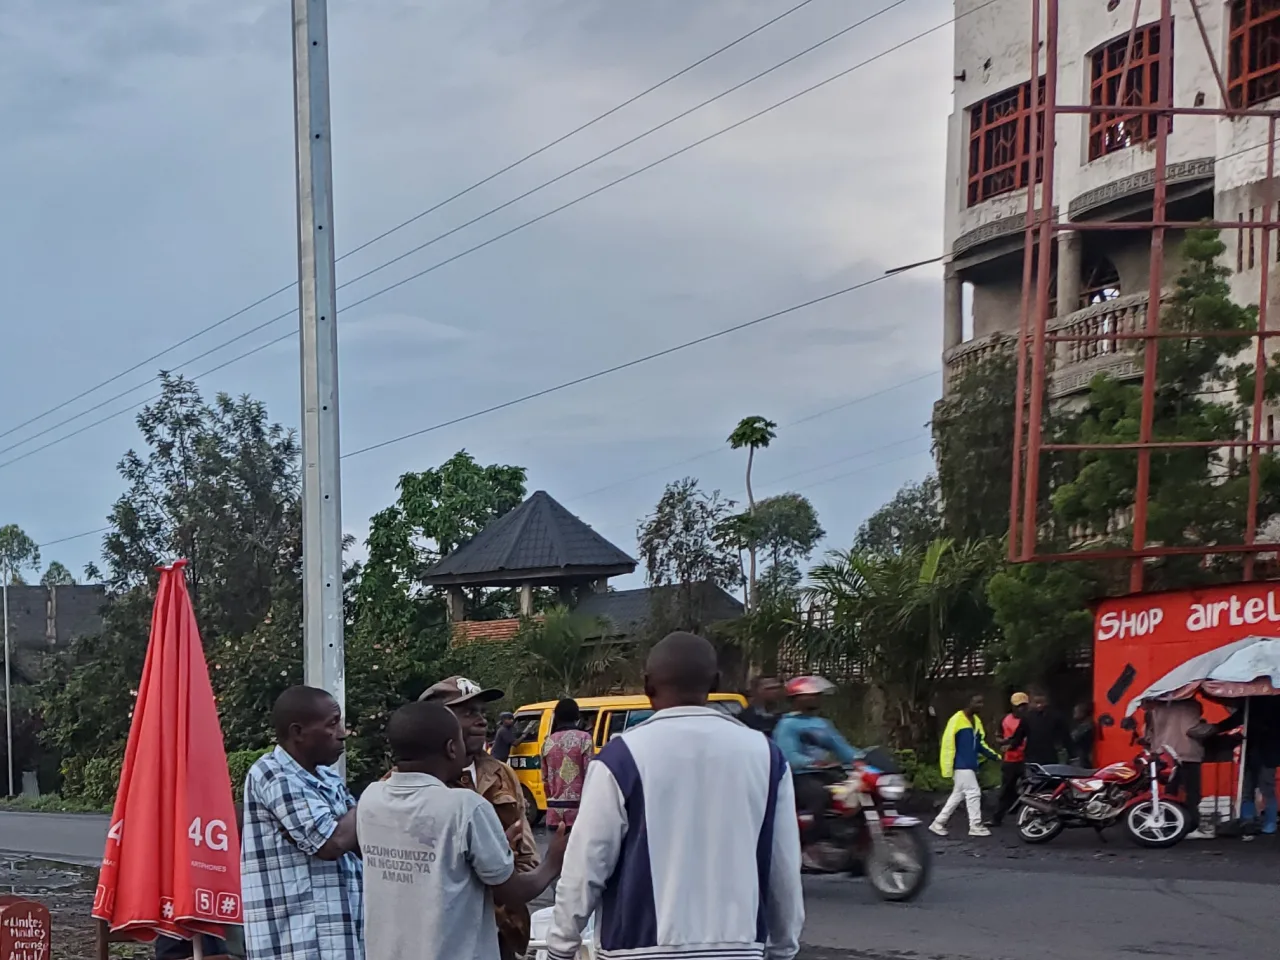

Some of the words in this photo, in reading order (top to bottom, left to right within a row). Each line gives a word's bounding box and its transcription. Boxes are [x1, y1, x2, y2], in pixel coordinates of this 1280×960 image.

[1097, 607, 1164, 641] SHOP
[188, 816, 228, 851] 4G
[367, 856, 376, 867] NI
[378, 857, 413, 872] NGUZO
[415, 863, 431, 874] YA
[382, 870, 414, 884] AMANI
[200, 893, 210, 910] 5
